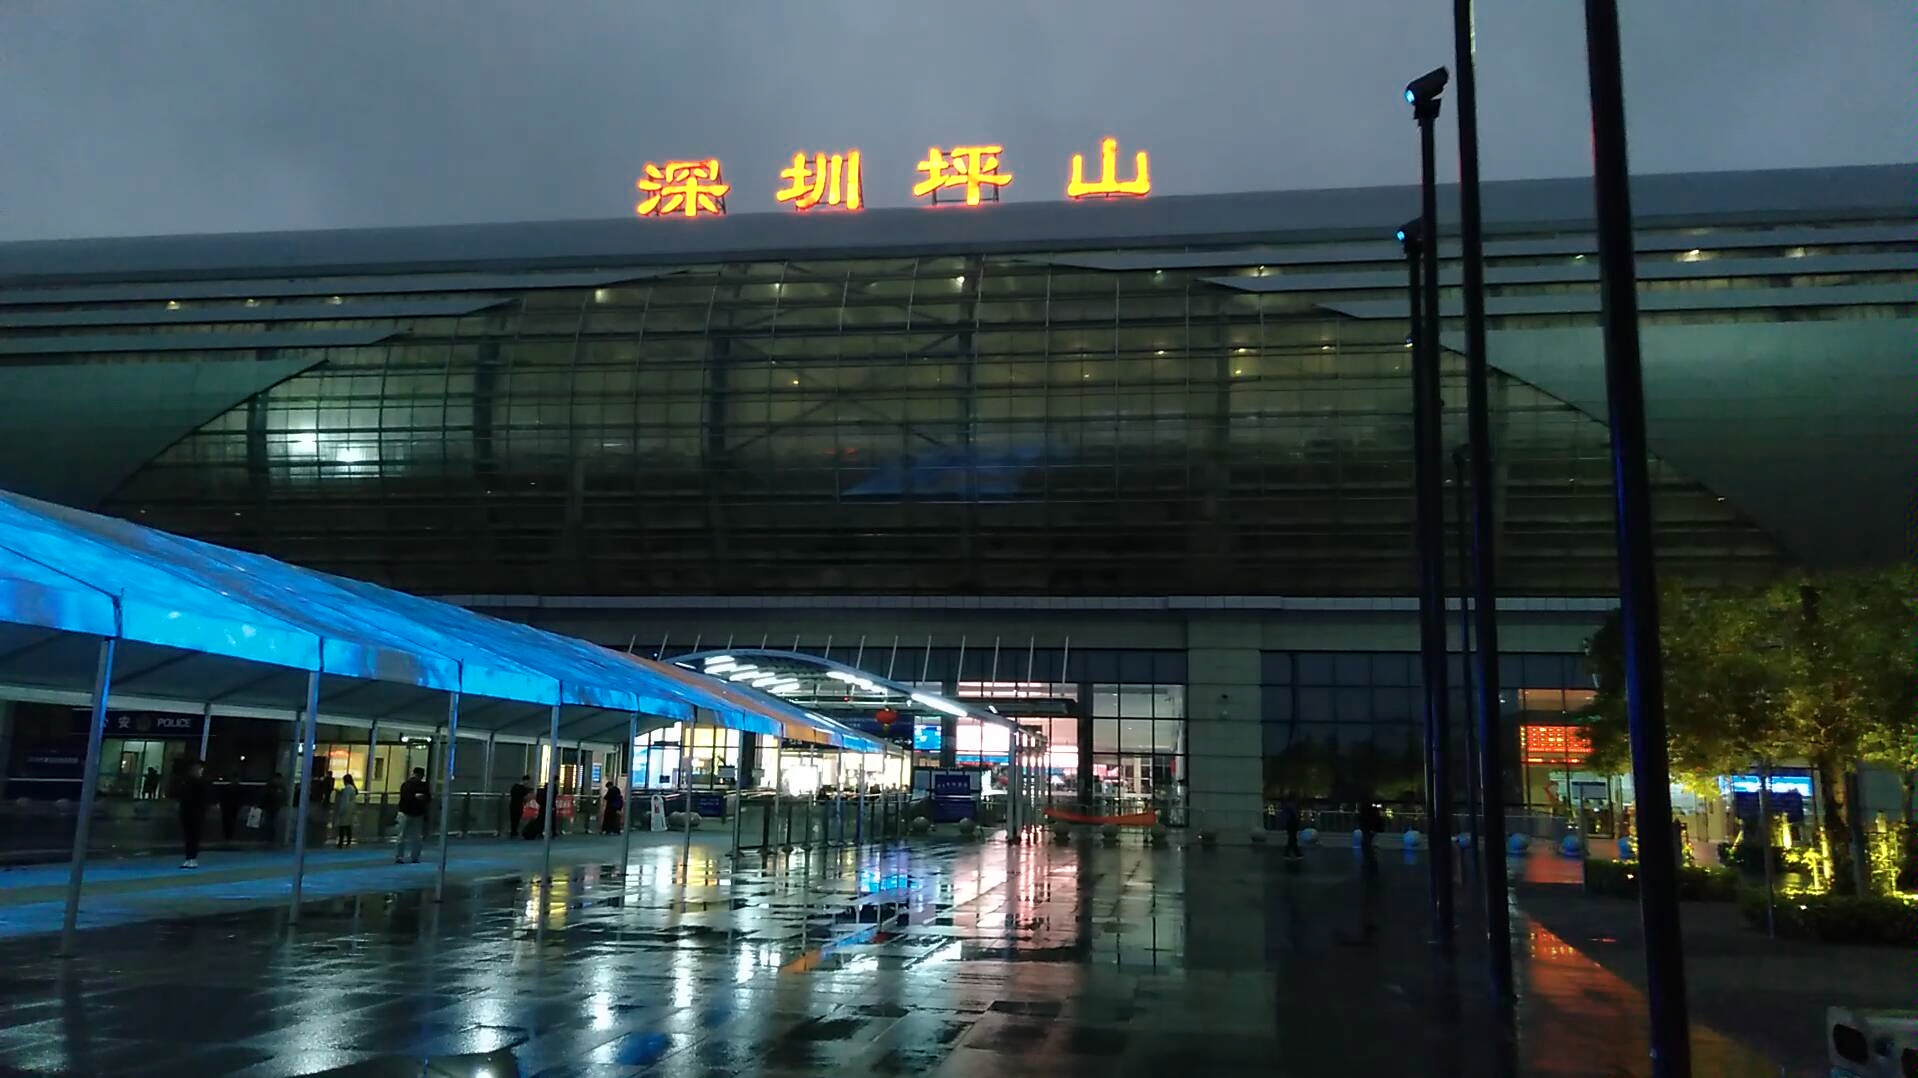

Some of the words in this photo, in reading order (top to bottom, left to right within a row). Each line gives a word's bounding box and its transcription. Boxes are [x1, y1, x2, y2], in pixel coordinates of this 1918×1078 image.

[637, 137, 1152, 217] 深圳坪山
[157, 717, 192, 729] POLICE
